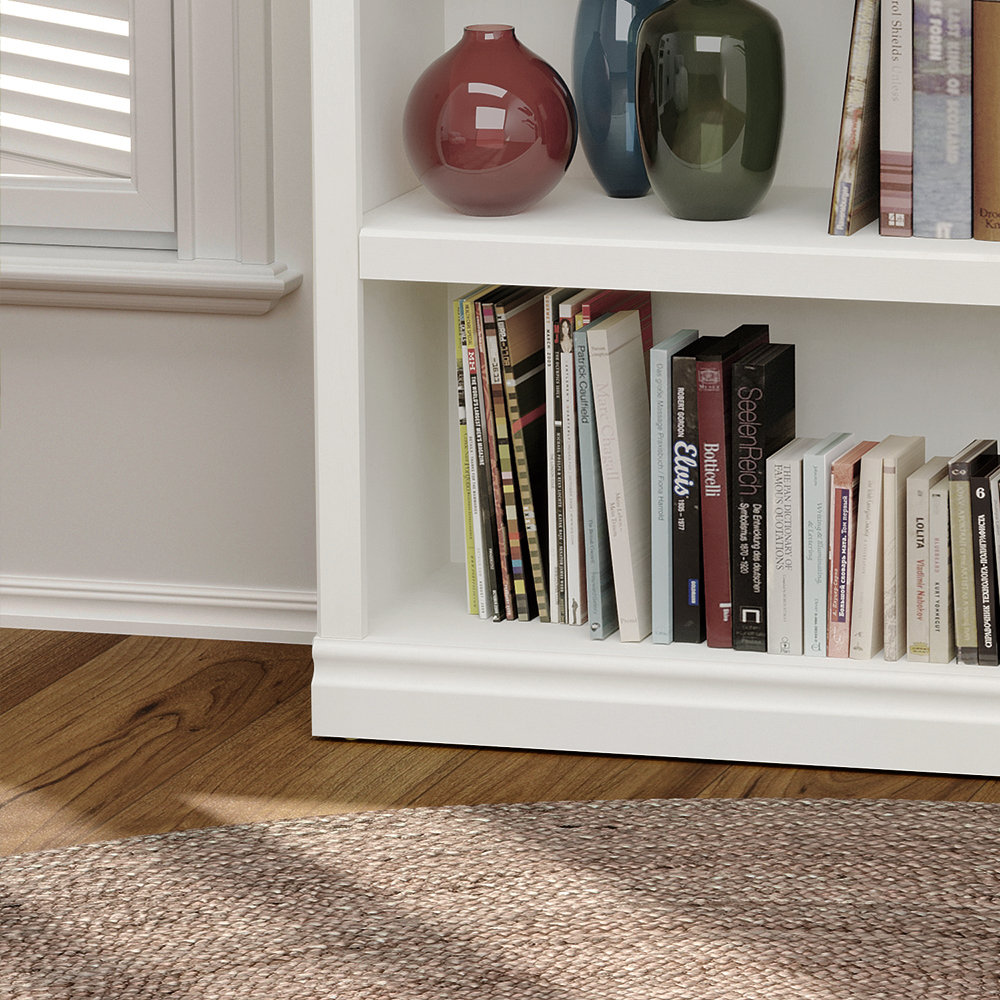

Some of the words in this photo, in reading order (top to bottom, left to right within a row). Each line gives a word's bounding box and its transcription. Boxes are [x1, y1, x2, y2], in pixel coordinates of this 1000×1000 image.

[891, 20, 902, 61] Shields
[929, 18, 942, 61] FODEN
[947, 78, 960, 95] OF
[577, 345, 586, 378] Patrick
[579, 381, 589, 424] Caulfield
[597, 383, 610, 417] Marc
[677, 387, 685, 410] ROBERT
[656, 400, 664, 431] Massage
[677, 411, 685, 437] GORDON
[737, 387, 763, 495] SeelenReich
[673, 440, 698, 496] Elvis
[703, 443, 721, 497] Botticelli
[774, 464, 783, 504] FAMOUS
[783, 465, 791, 483] THE
[753, 504, 762, 513] Die
[783, 485, 791, 502] PAN
[976, 487, 985, 499] 6
[738, 503, 748, 541] Symbolismus
[751, 514, 762, 549] Entwicklung
[783, 504, 792, 556] DICTIONARY
[916, 517, 924, 549] LOLITA
[740, 543, 749, 556] 1870
[775, 507, 784, 571] QUOTATIONS
[740, 561, 749, 574] 1920
[753, 550, 762, 561] des
[785, 559, 792, 570] OF
[752, 563, 762, 593] deutschen
[916, 559, 925, 588] Vladimir
[838, 584, 846, 617] Большой
[917, 590, 926, 621] Nabokov
[983, 605, 993, 648] СПРАВОЧНИК
